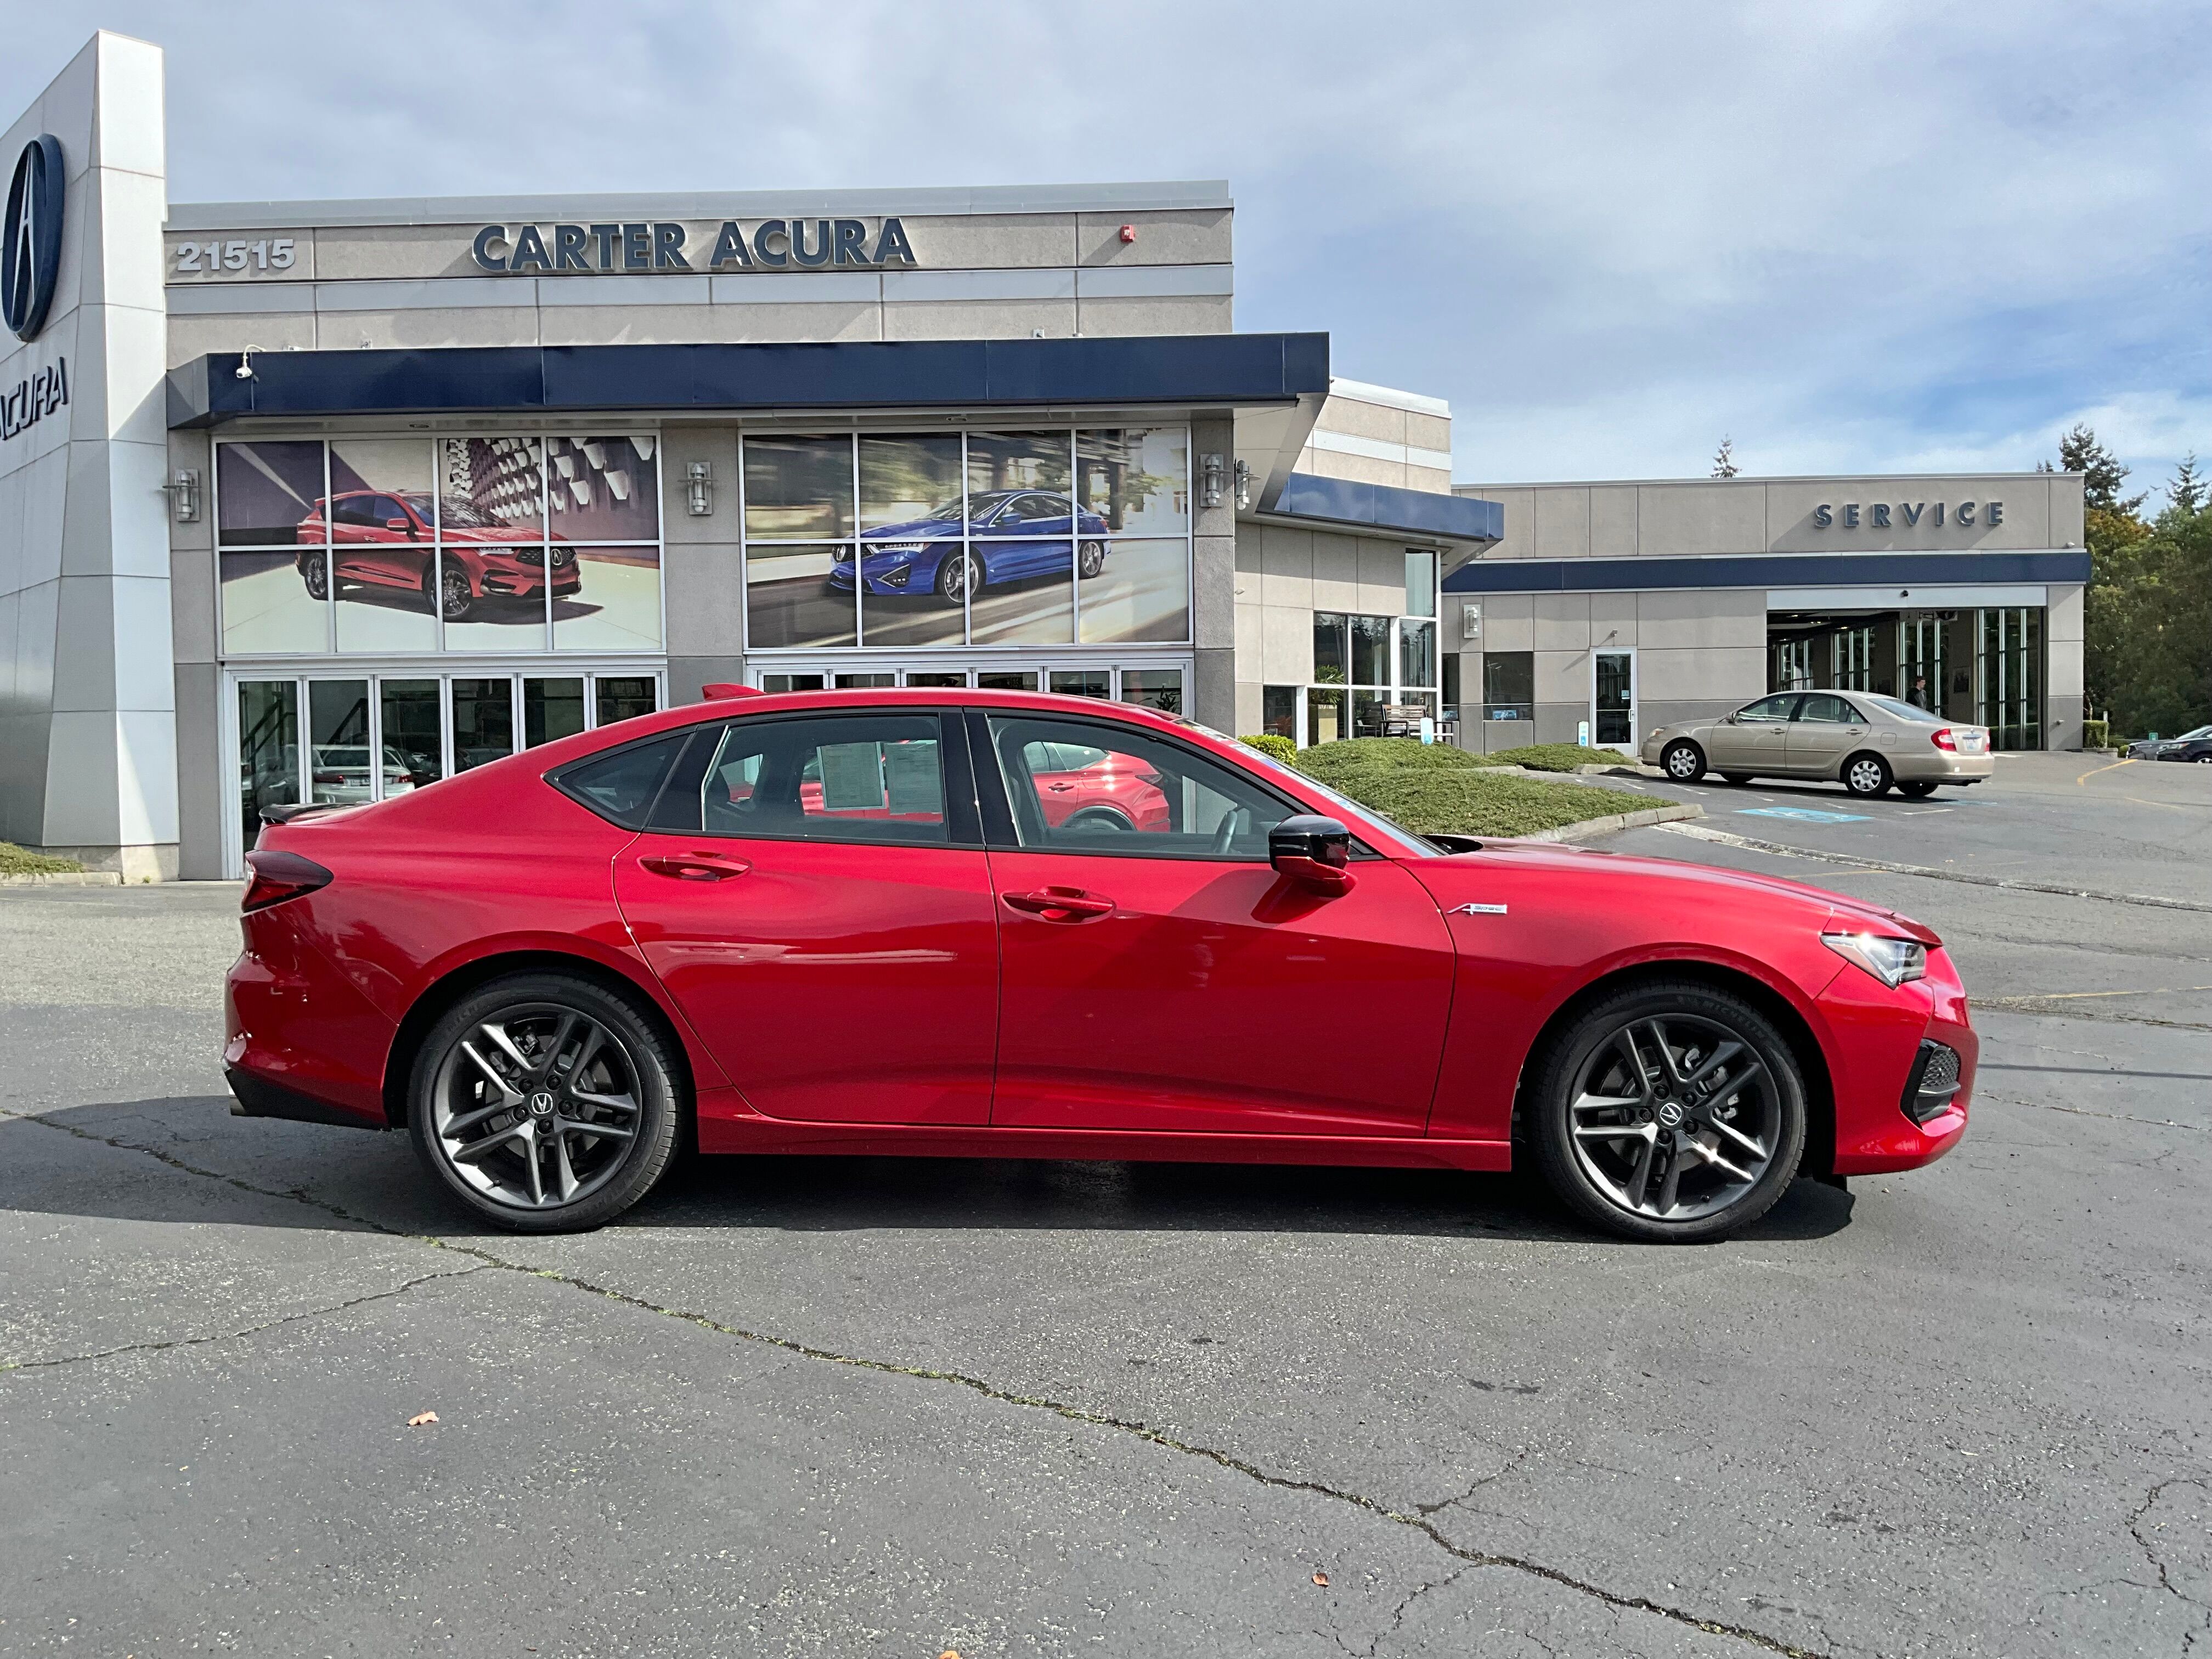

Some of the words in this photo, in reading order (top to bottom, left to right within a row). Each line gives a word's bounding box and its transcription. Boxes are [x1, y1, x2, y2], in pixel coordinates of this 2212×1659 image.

[177, 239, 295, 271] 21515
[472, 223, 693, 273] CARTER
[708, 217, 917, 269] ACURA
[1814, 501, 2003, 528] SERVICE
